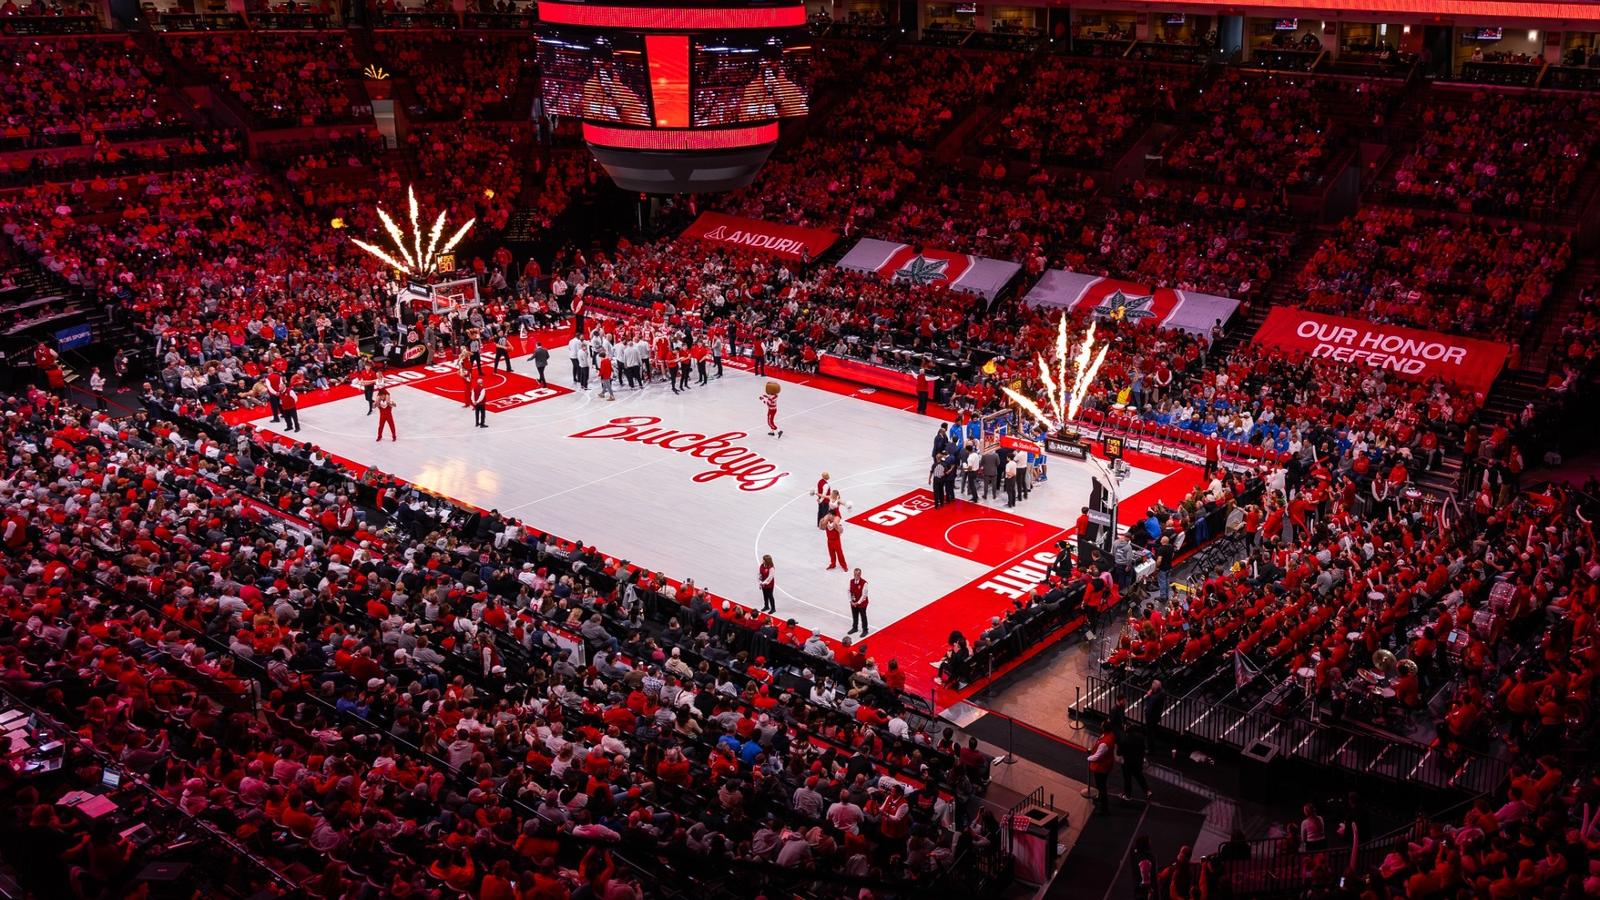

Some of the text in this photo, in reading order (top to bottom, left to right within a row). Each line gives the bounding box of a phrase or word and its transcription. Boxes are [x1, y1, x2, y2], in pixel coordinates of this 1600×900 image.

[726, 231, 803, 254] ANDURIL
[1296, 321, 1467, 365] OUR HONOR
[1312, 343, 1426, 374] DEFEND
[566, 415, 790, 492] Buckeyes
